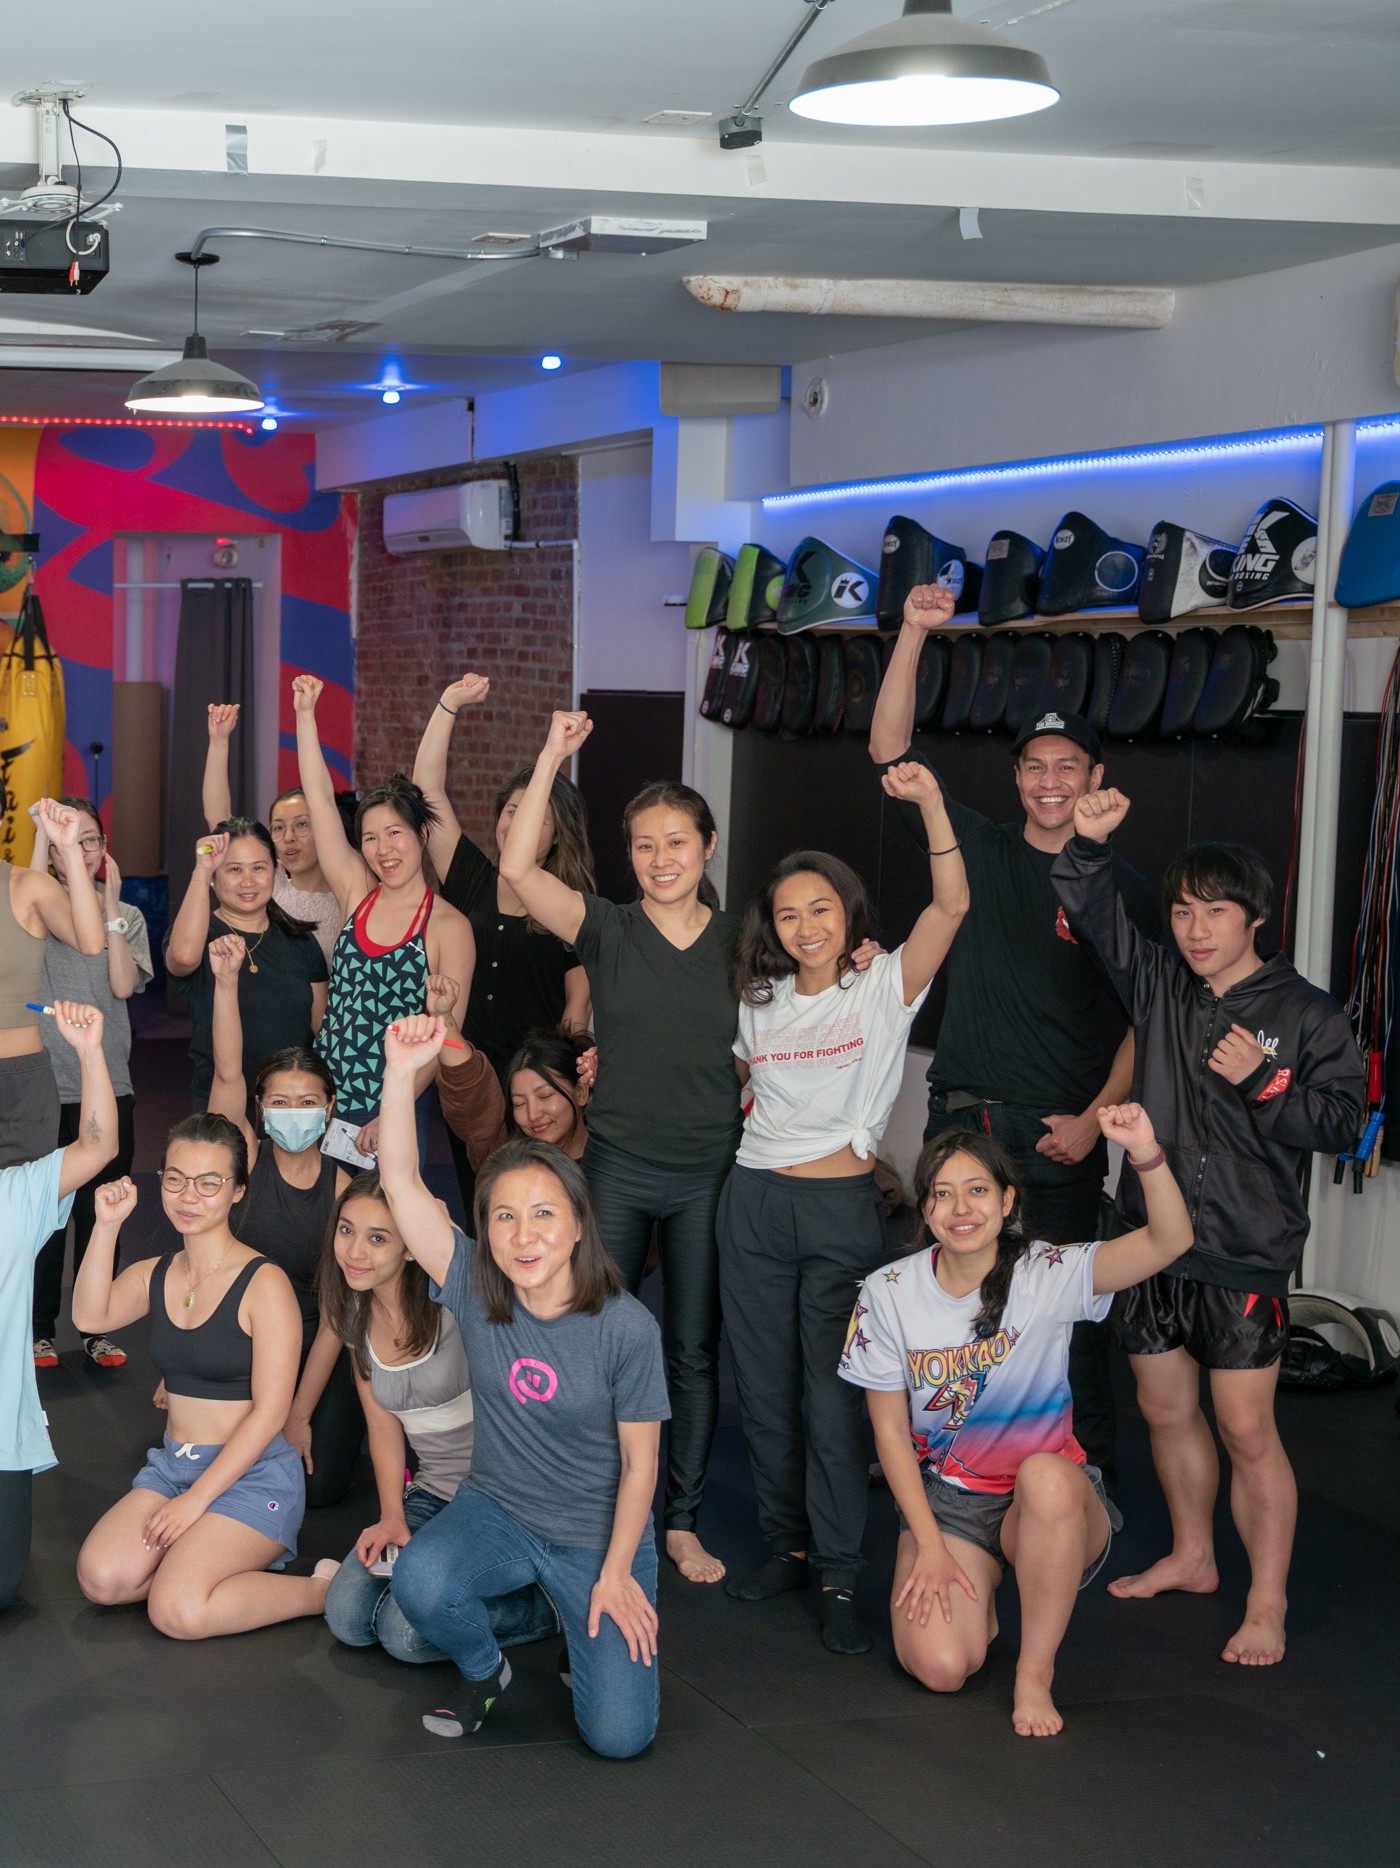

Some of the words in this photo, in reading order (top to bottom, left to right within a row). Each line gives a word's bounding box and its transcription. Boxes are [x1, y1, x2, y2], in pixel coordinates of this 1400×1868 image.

[771, 1052, 791, 1061] YOU
[794, 1050, 814, 1060] FOR
[816, 1037, 864, 1058] FIGHTING
[907, 1327, 1010, 1391] YOKKAO
